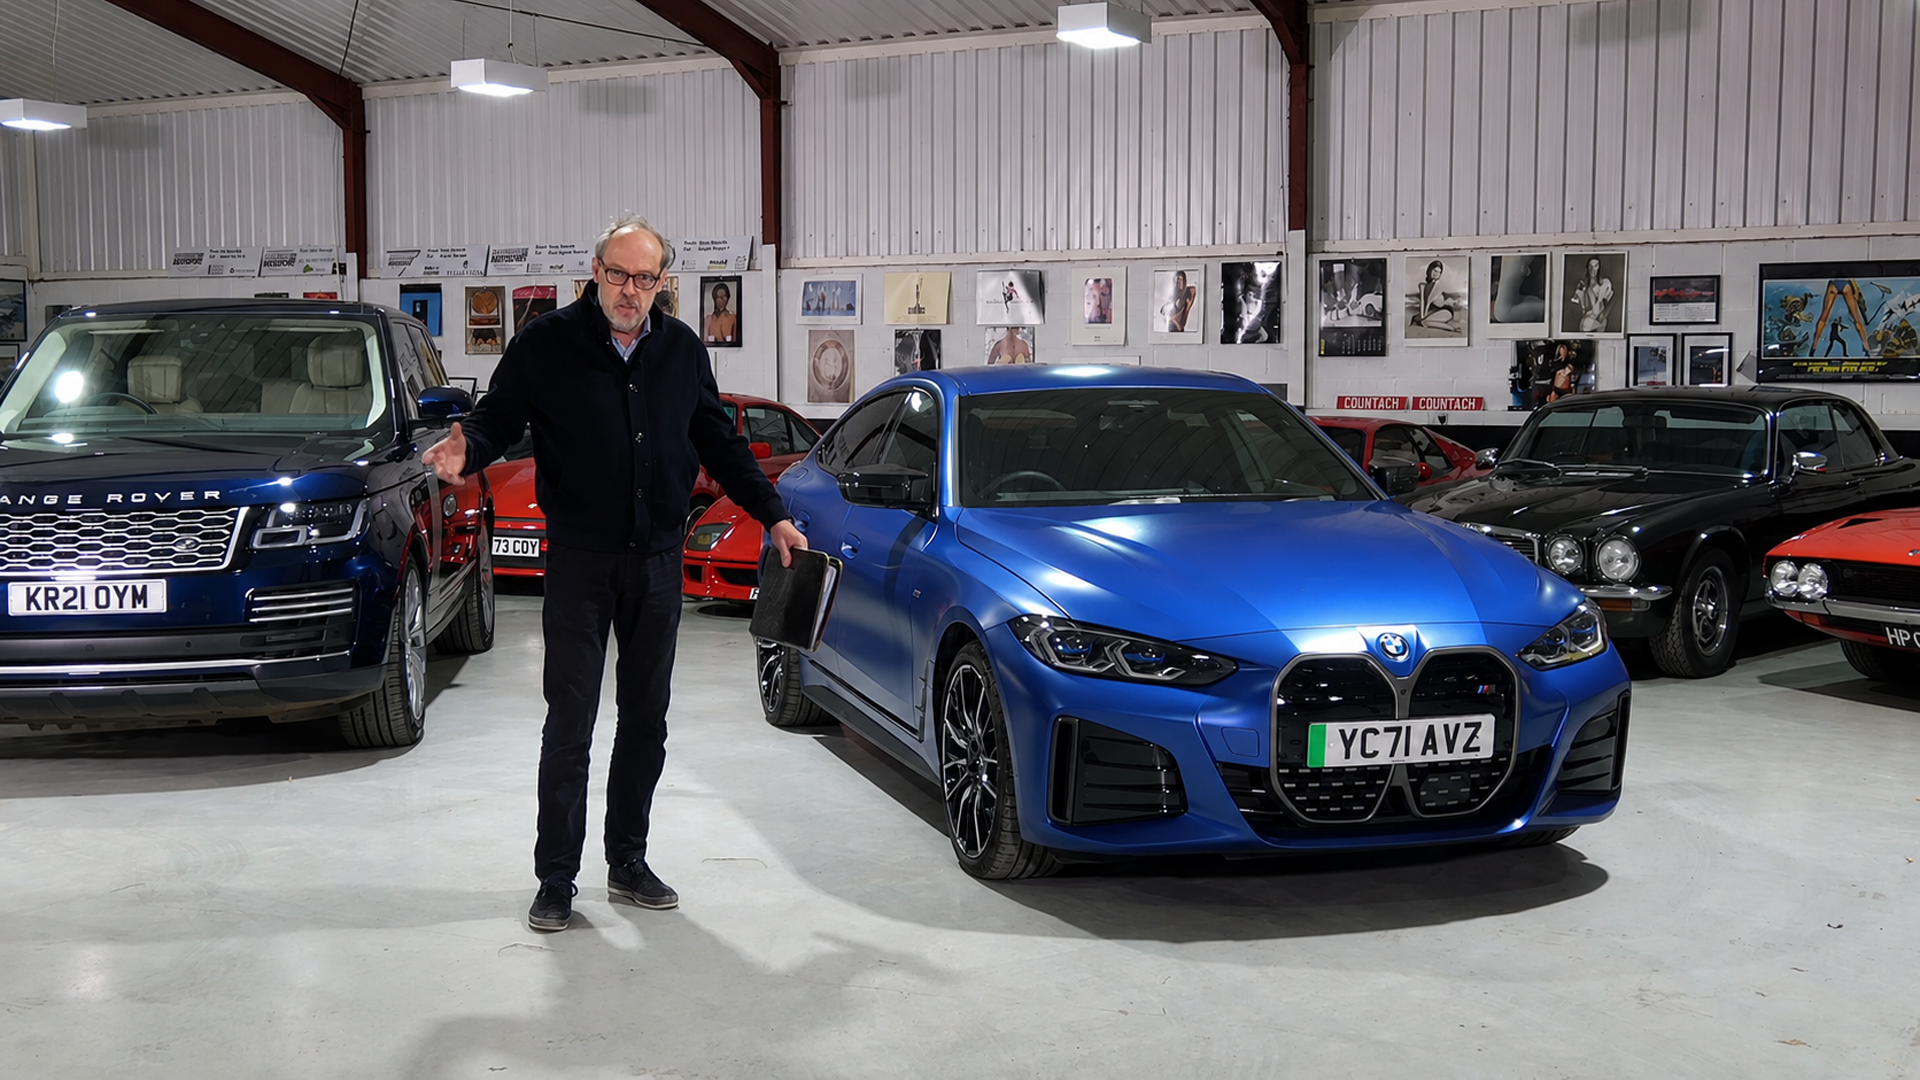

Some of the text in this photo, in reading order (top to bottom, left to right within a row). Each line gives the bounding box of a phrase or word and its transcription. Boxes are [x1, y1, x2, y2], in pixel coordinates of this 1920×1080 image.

[1344, 397, 1399, 410] COUNTACH
[1419, 397, 1475, 410] COUNTACH
[106, 490, 220, 503] ROVER
[494, 538, 538, 555] 73 COY
[25, 584, 148, 611] KR21 OYM
[1885, 626, 1911, 647] HP
[1338, 721, 1482, 760] YC71 AVZ
